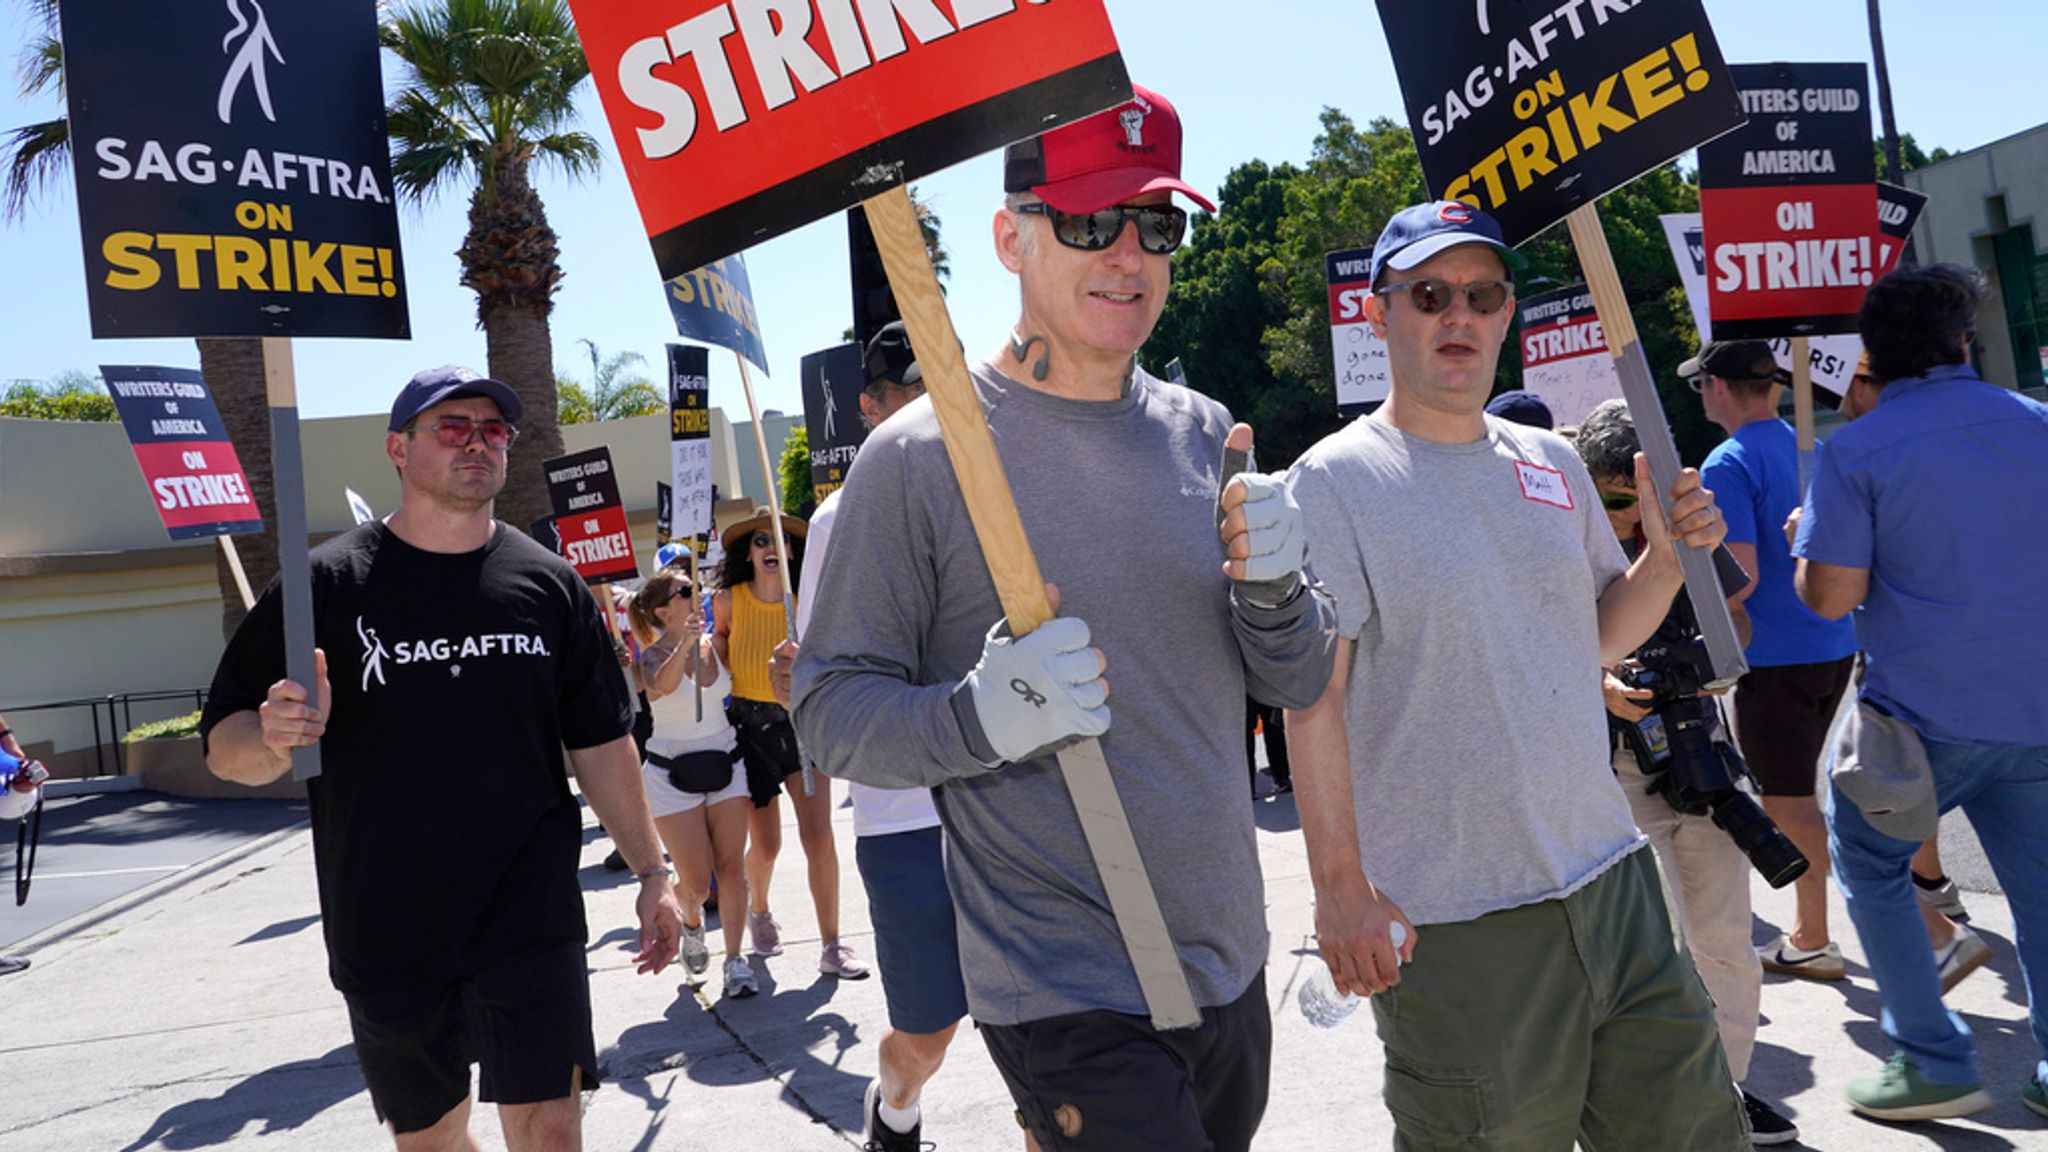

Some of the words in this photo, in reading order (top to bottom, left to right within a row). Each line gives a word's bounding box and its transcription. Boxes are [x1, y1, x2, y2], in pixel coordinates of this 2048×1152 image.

[1513, 69, 1566, 120] ON
[1737, 89, 1799, 113] ITERS
[1802, 88, 1860, 112] GUILD
[1443, 32, 1710, 211] STRIKE!
[1775, 121, 1798, 141] OF
[1742, 149, 1836, 175] AMERICA
[234, 200, 293, 231] ON
[1776, 201, 1815, 231] ON
[1877, 198, 1908, 226] ILD
[101, 230, 398, 299] STRIKE!
[1713, 236, 1873, 293] STRIKE!
[1522, 298, 1570, 323] WRITERS
[113, 381, 174, 398] WRITERS
[172, 382, 206, 399] GUILD
[164, 401, 179, 414] OF
[151, 419, 208, 436] AMERICA
[182, 450, 208, 470] ON
[154, 472, 251, 510] STRIKE!
[583, 518, 600, 535] ON
[566, 530, 630, 566] STRIKE!
